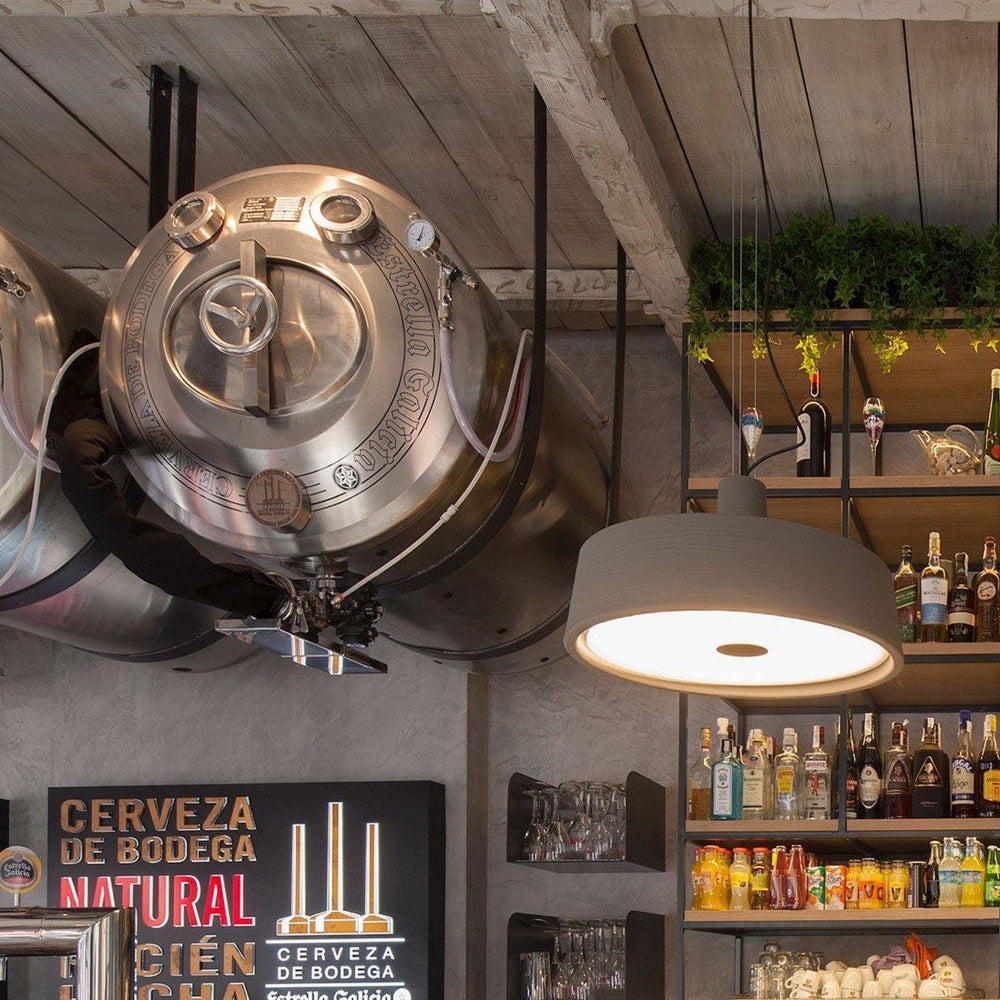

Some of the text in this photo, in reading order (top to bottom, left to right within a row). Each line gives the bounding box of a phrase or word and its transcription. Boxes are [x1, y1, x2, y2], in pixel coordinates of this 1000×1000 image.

[354, 236, 435, 471] Estrella Galicia
[126, 250, 233, 498] CERVEZA DE BODEGA
[60, 796, 257, 833] CERVEZA
[60, 834, 257, 864] DE BODEGA
[60, 874, 256, 928] NATURAL
[59, 935, 256, 978] CIÉN
[277, 947, 395, 962] CERVEZA
[277, 965, 394, 980] DE BODEGA
